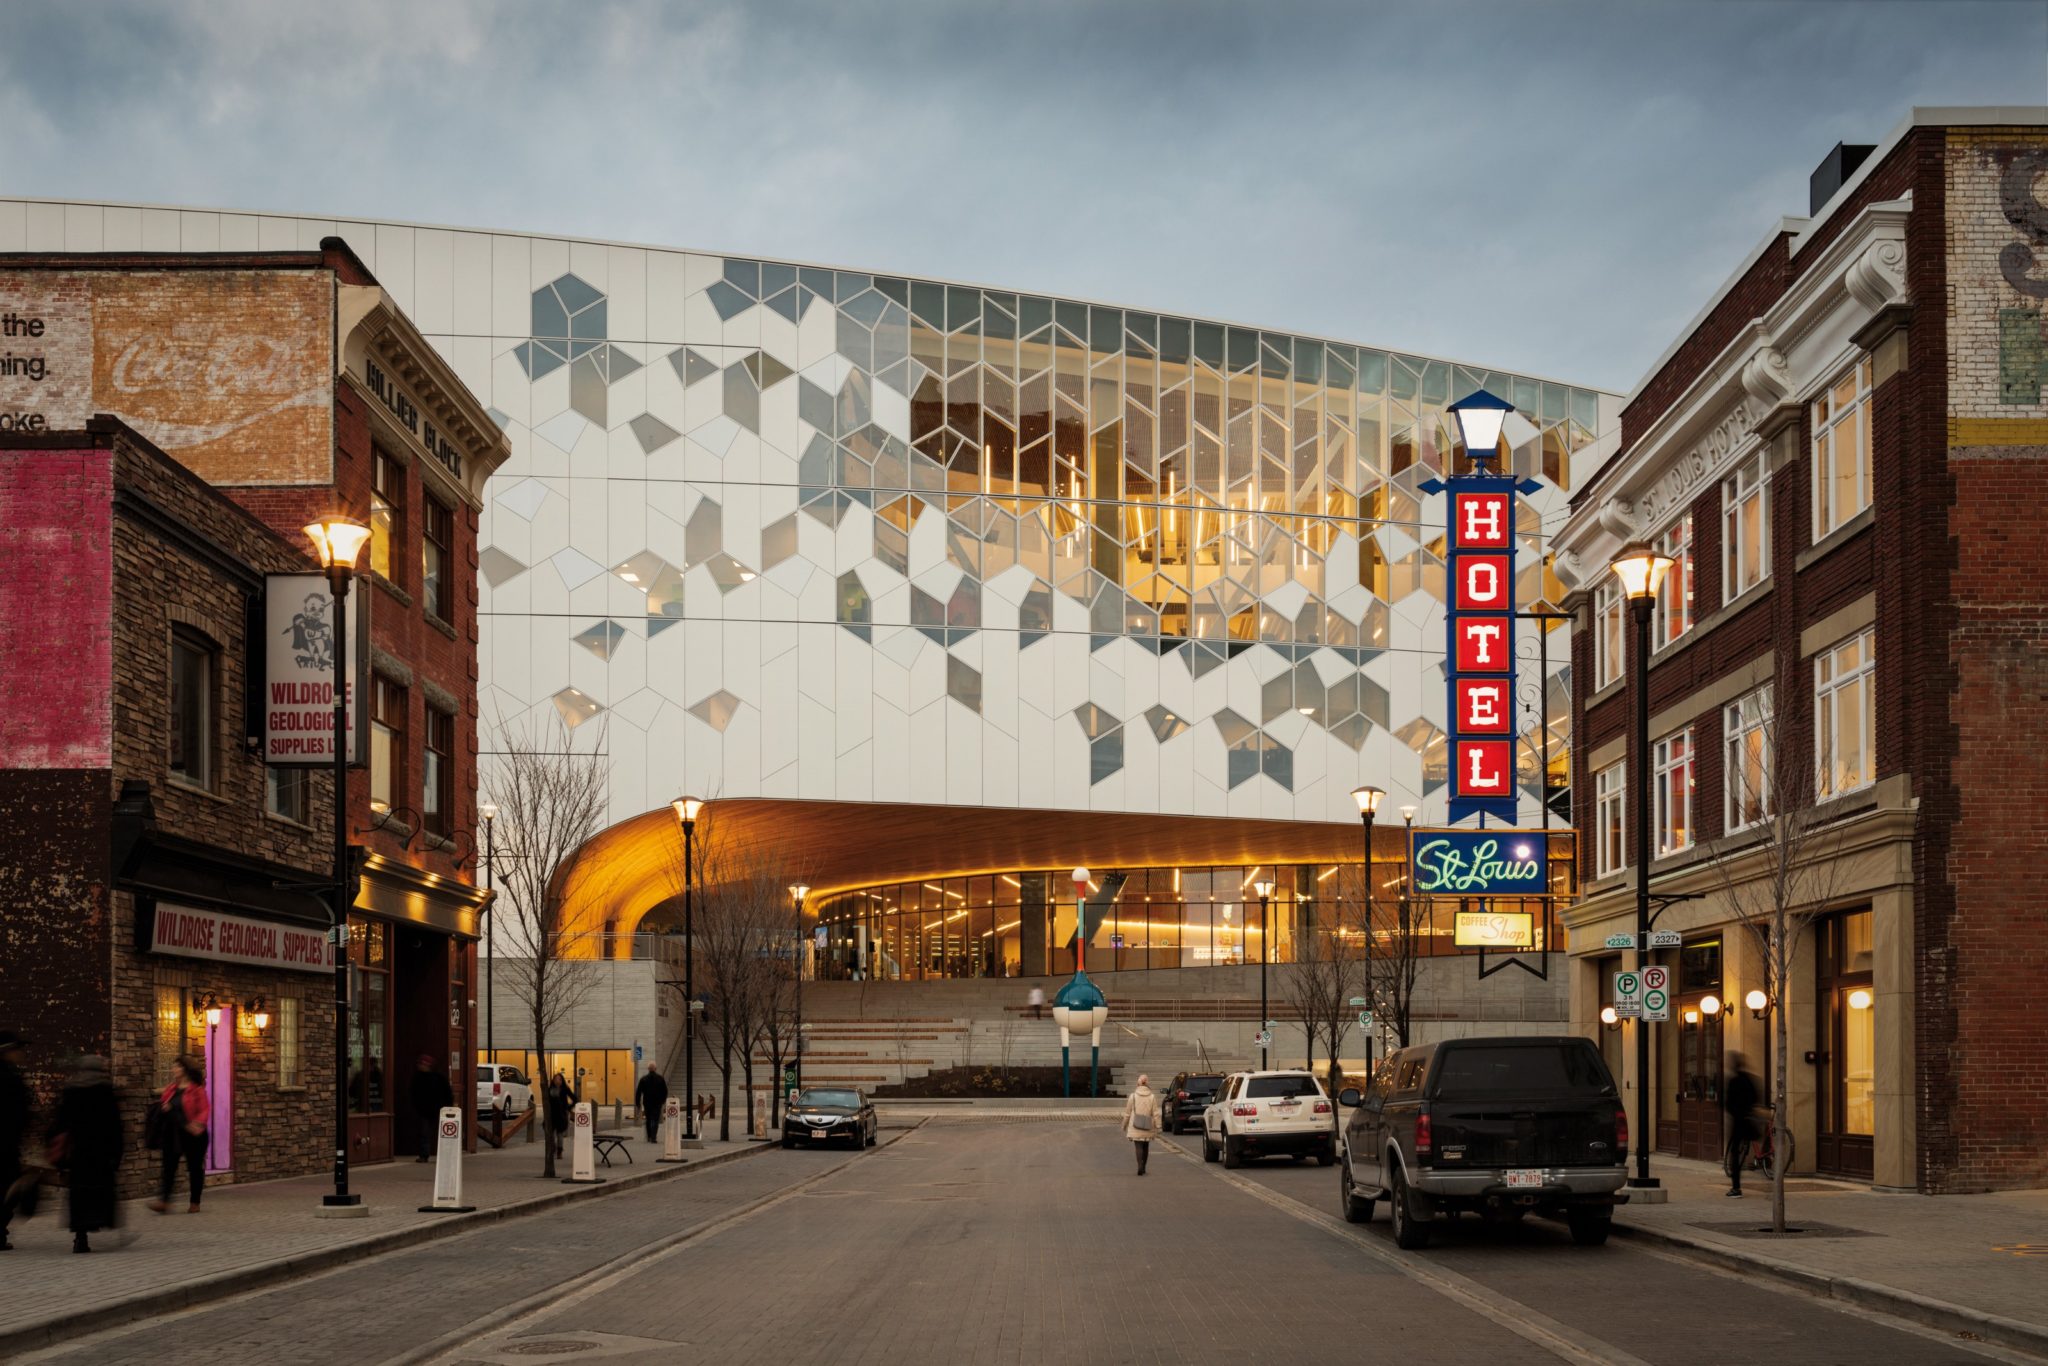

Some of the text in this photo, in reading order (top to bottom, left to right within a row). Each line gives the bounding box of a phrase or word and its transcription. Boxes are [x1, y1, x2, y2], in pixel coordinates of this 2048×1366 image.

[2, 313, 45, 337] the
[366, 359, 462, 480] HILLIER BLOCK
[1663, 446, 1706, 504] LOUIS
[1703, 398, 1761, 466] HOTEL
[1464, 501, 1502, 788] HOTEL
[271, 681, 352, 705] WILDROE
[269, 711, 353, 731] GEOLOGICL
[270, 738, 352, 755] SUPPLIES L.
[1416, 839, 1538, 890] St. Louis
[156, 910, 215, 952] WILDROSE
[219, 921, 278, 960] GEOLOGICAL
[282, 931, 323, 966] SUPPLIES
[1460, 916, 1526, 943] COFFEE Shop
[1655, 935, 1676, 944] 2327
[1611, 937, 1631, 947] 2326
[1624, 978, 1633, 991] P
